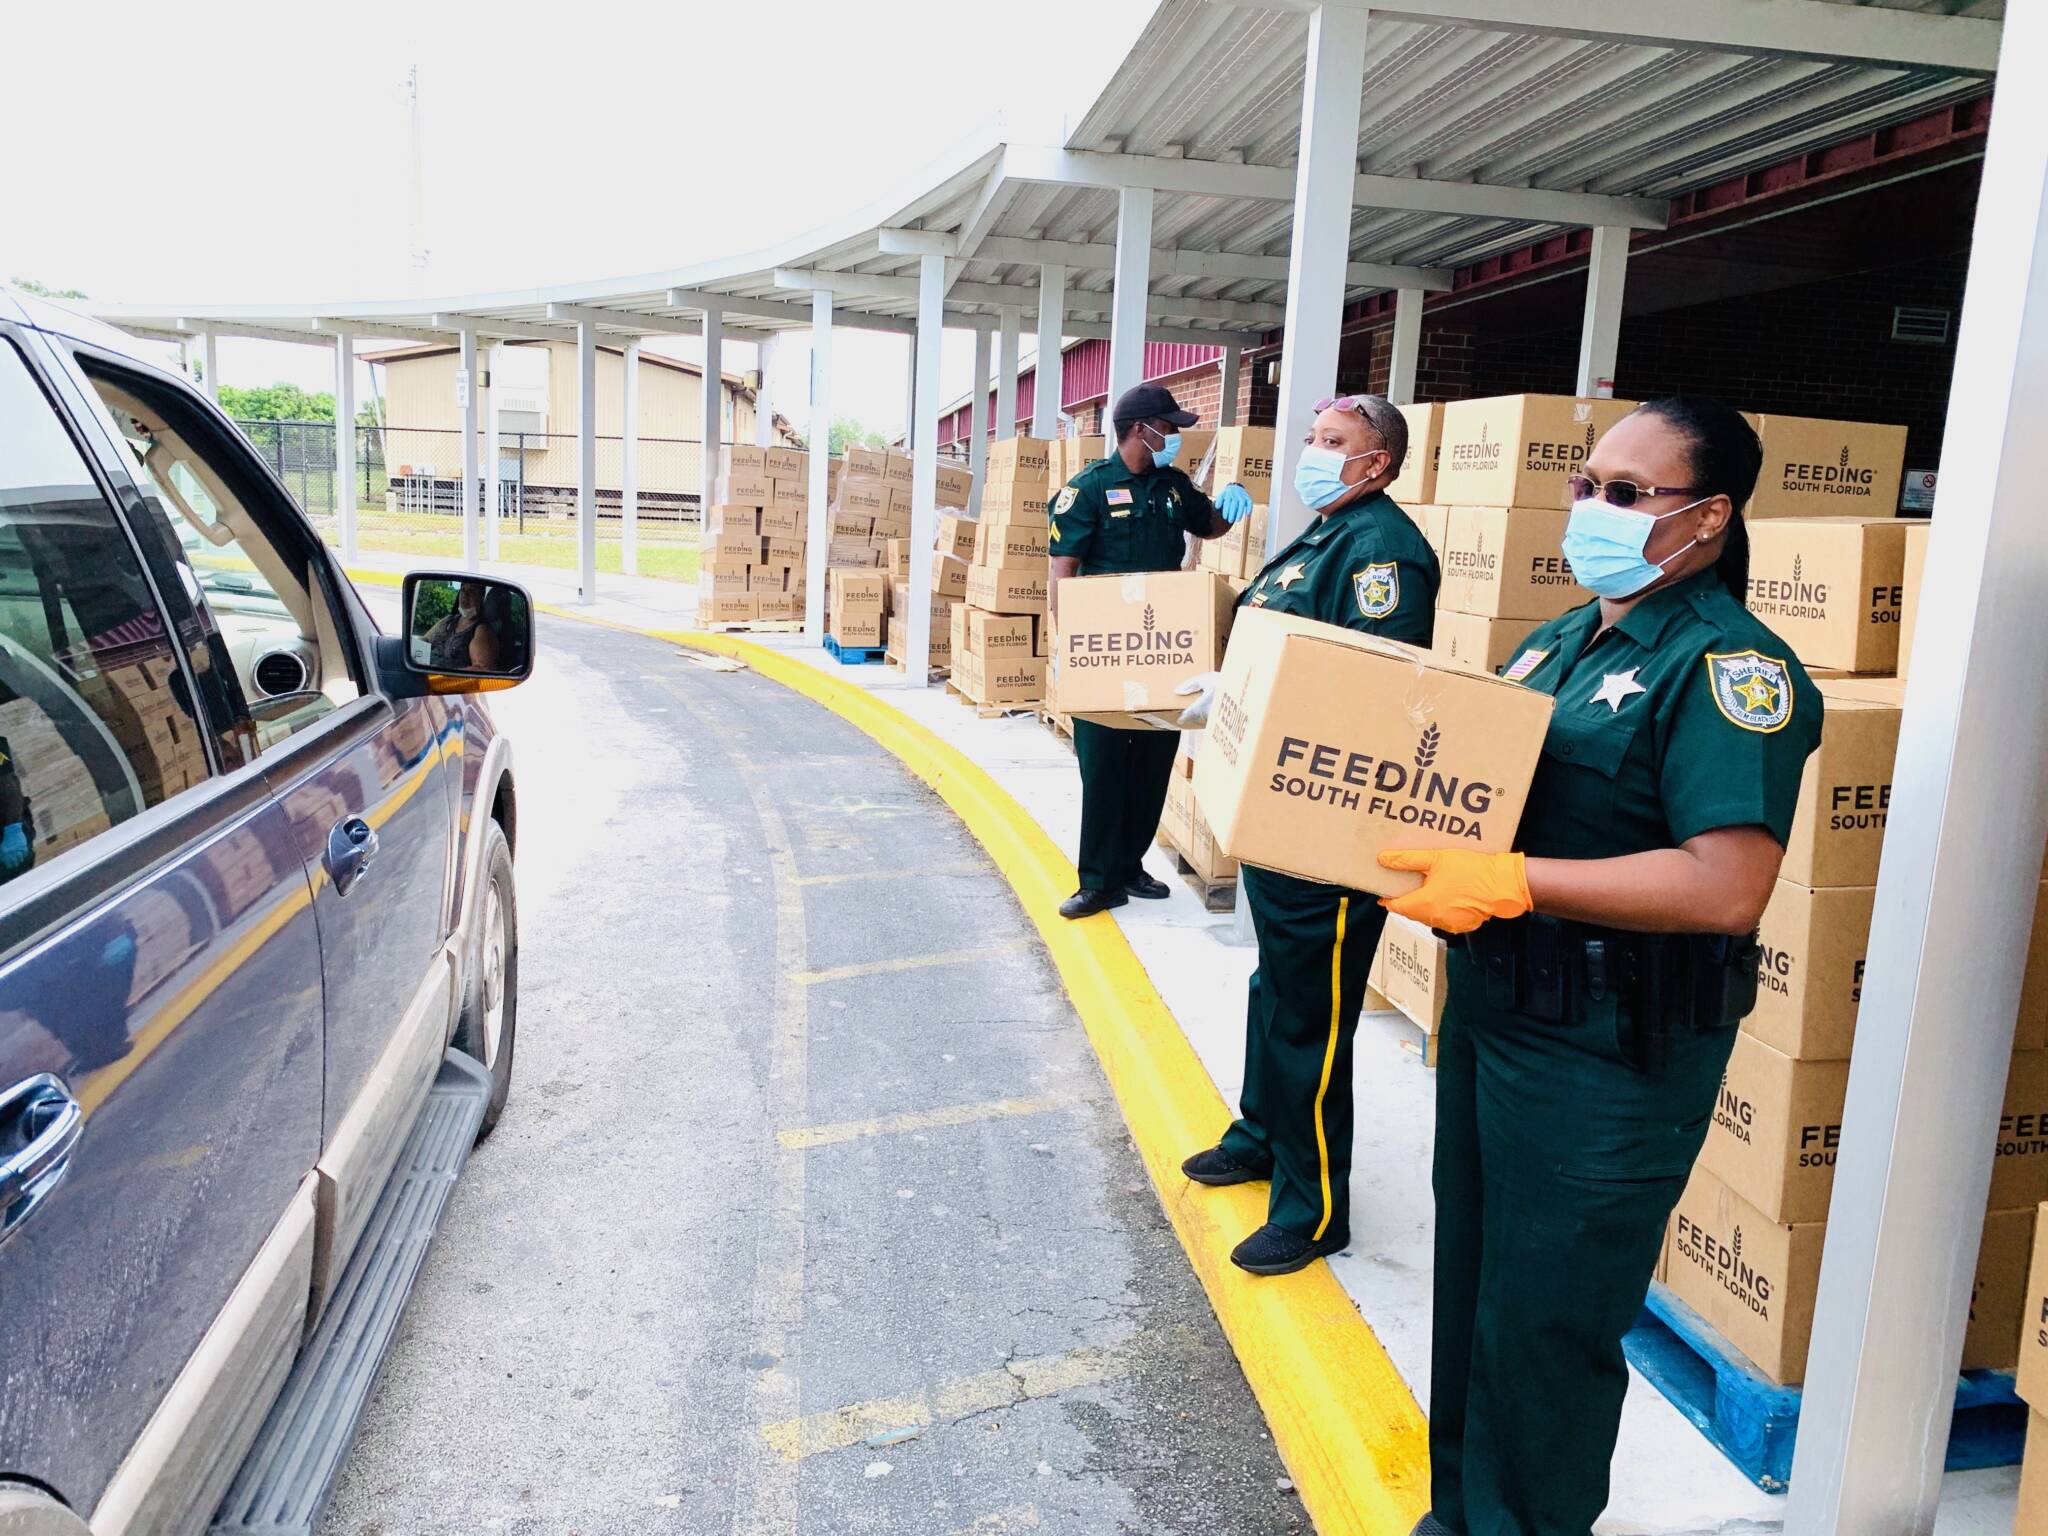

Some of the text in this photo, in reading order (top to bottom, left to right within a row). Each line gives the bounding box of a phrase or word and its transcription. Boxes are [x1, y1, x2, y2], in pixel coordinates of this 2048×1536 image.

[1453, 442, 1500, 459] FEEDING
[1528, 442, 1590, 461] FEEDI
[1244, 457, 1273, 470] FEE
[1452, 460, 1498, 471] SOUTH FLORIDA
[1526, 460, 1565, 473] SOUTH
[1243, 470, 1271, 478] SOUTH
[1784, 463, 1873, 484] FEEDING
[1782, 481, 1871, 496] SOUTH FLORIDA
[1023, 500, 1048, 509] FEED
[1007, 543, 1047, 553] FEEDING
[1448, 551, 1495, 569] FEEDING
[1532, 556, 1573, 574] FEE
[1447, 567, 1494, 581] SOUTH FLORIDA
[1530, 574, 1570, 585] SOUTH
[1008, 587, 1047, 596] FEEDING
[1779, 604, 1826, 620] FLORIDA
[1871, 611, 1900, 624] SOU
[987, 634, 1027, 643] FEEDING
[1070, 630, 1193, 653] FEEDING
[1070, 653, 1194, 668] SOUTH FLORIDA
[996, 674, 1036, 683] FEEDING
[1832, 784, 1891, 810] FEE
[1270, 773, 1483, 841] SOUTH FLORIDA
[1389, 942, 1430, 981] FEEDING
[1758, 970, 1789, 996] RIDA
[1719, 1086, 1752, 1125] ING
[1712, 1113, 1751, 1146] LORIDA
[1799, 1152, 1836, 1167] SOU
[1678, 1214, 1771, 1300] FEEDING
[1677, 1238, 1769, 1322] SOUTH FLORIDA
